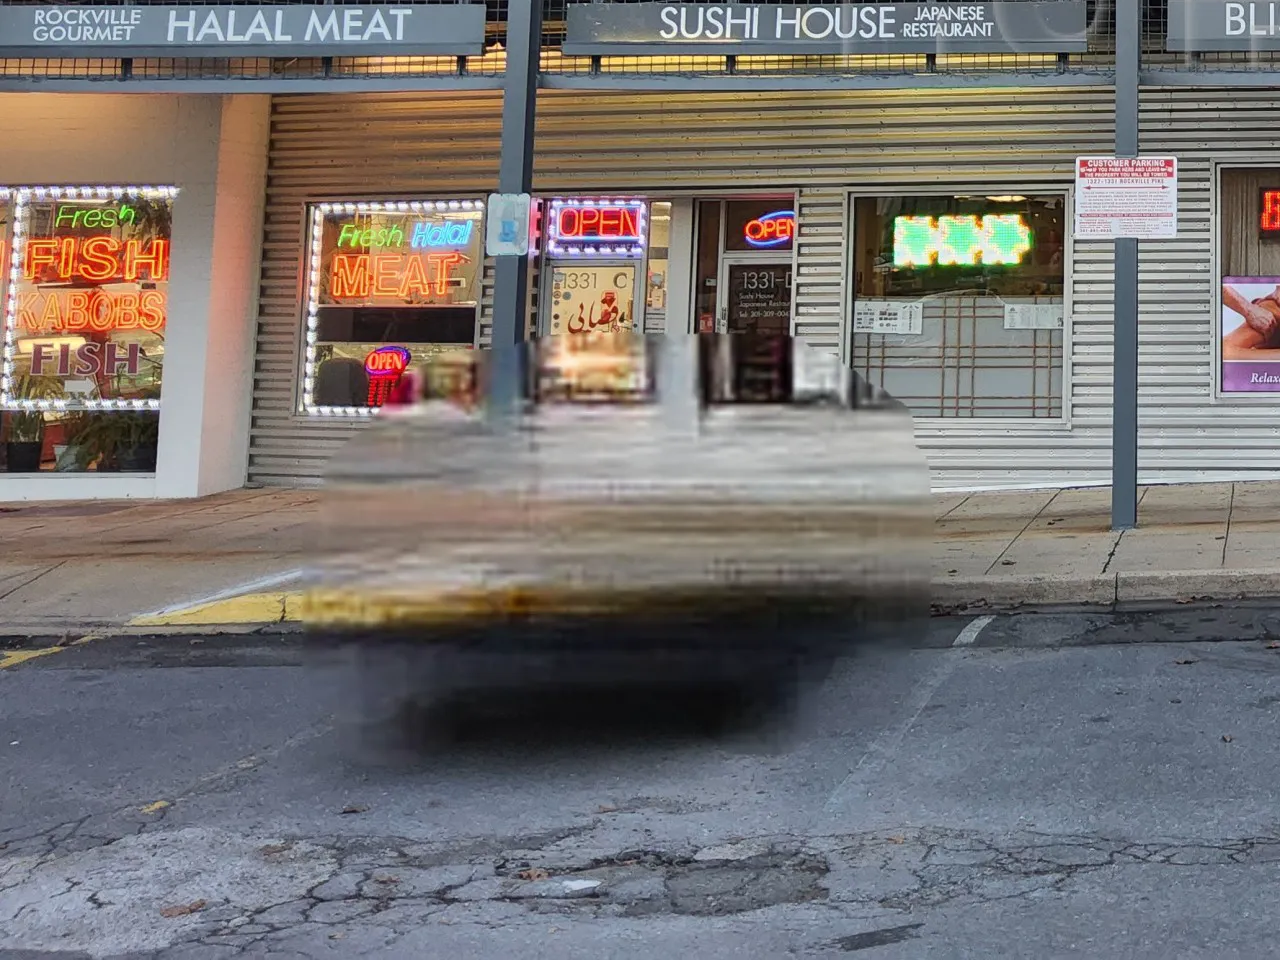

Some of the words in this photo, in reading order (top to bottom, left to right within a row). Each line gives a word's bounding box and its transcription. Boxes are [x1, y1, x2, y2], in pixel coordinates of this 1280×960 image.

[34, 9, 141, 25] ROCKVILLE
[167, 9, 292, 41] HALAL
[304, 8, 413, 41] MEAT
[659, 6, 759, 39] SUSHI
[775, 6, 897, 39] HOUSE
[914, 6, 985, 21] JAPANESE
[33, 25, 135, 41] GOURMET
[903, 22, 995, 38] RESTAURANT
[1087, 159, 1130, 167] CUSTOMER
[1131, 159, 1165, 167] PARKING
[55, 205, 135, 228] Fresh
[560, 207, 640, 237] OPEN
[338, 224, 403, 247] Fresh
[411, 220, 472, 247] Halal
[24, 237, 165, 280] FISH
[333, 254, 458, 296] MEAT
[562, 272, 597, 289] 1331
[613, 271, 628, 289] C
[15, 291, 165, 330] KABOBS
[30, 342, 139, 376] FISH
[368, 352, 403, 370] OPEN
